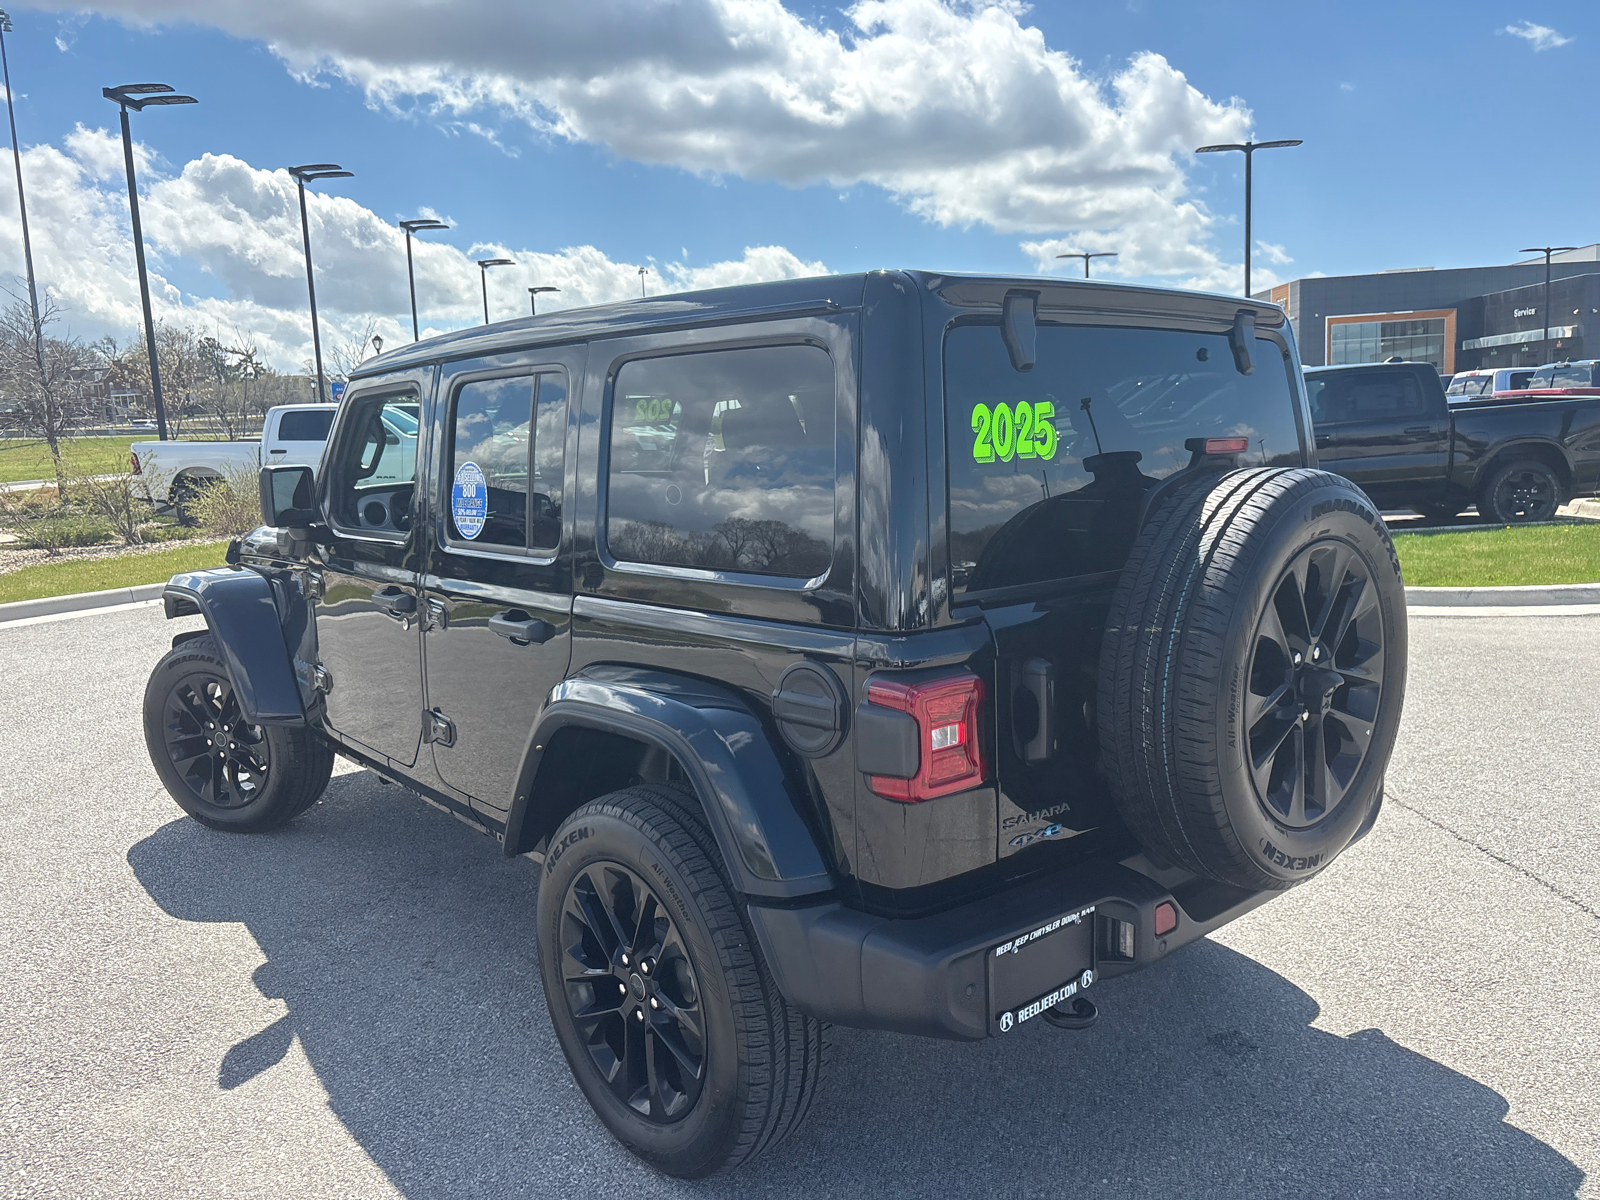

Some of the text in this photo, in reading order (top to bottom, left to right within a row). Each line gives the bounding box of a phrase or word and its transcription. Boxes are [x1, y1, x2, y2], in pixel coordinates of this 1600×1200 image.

[1513, 307, 1536, 318] Service
[971, 401, 1057, 463] 2025
[456, 498, 483, 508] MILE RANGE
[462, 485, 476, 497] 800
[1227, 662, 1240, 749] All-Weather
[1002, 802, 1071, 830] SAHARA
[546, 826, 590, 874] NEXEN
[1262, 840, 1320, 870] NEXEN
[651, 862, 692, 923] All-Weather
[995, 941, 1013, 957] REED
[1013, 934, 1029, 947] JEEP
[1029, 920, 1061, 941] CHRYSLER
[1081, 905, 1096, 917] RAM
[1018, 981, 1078, 1023] REEDJEEP.COM
